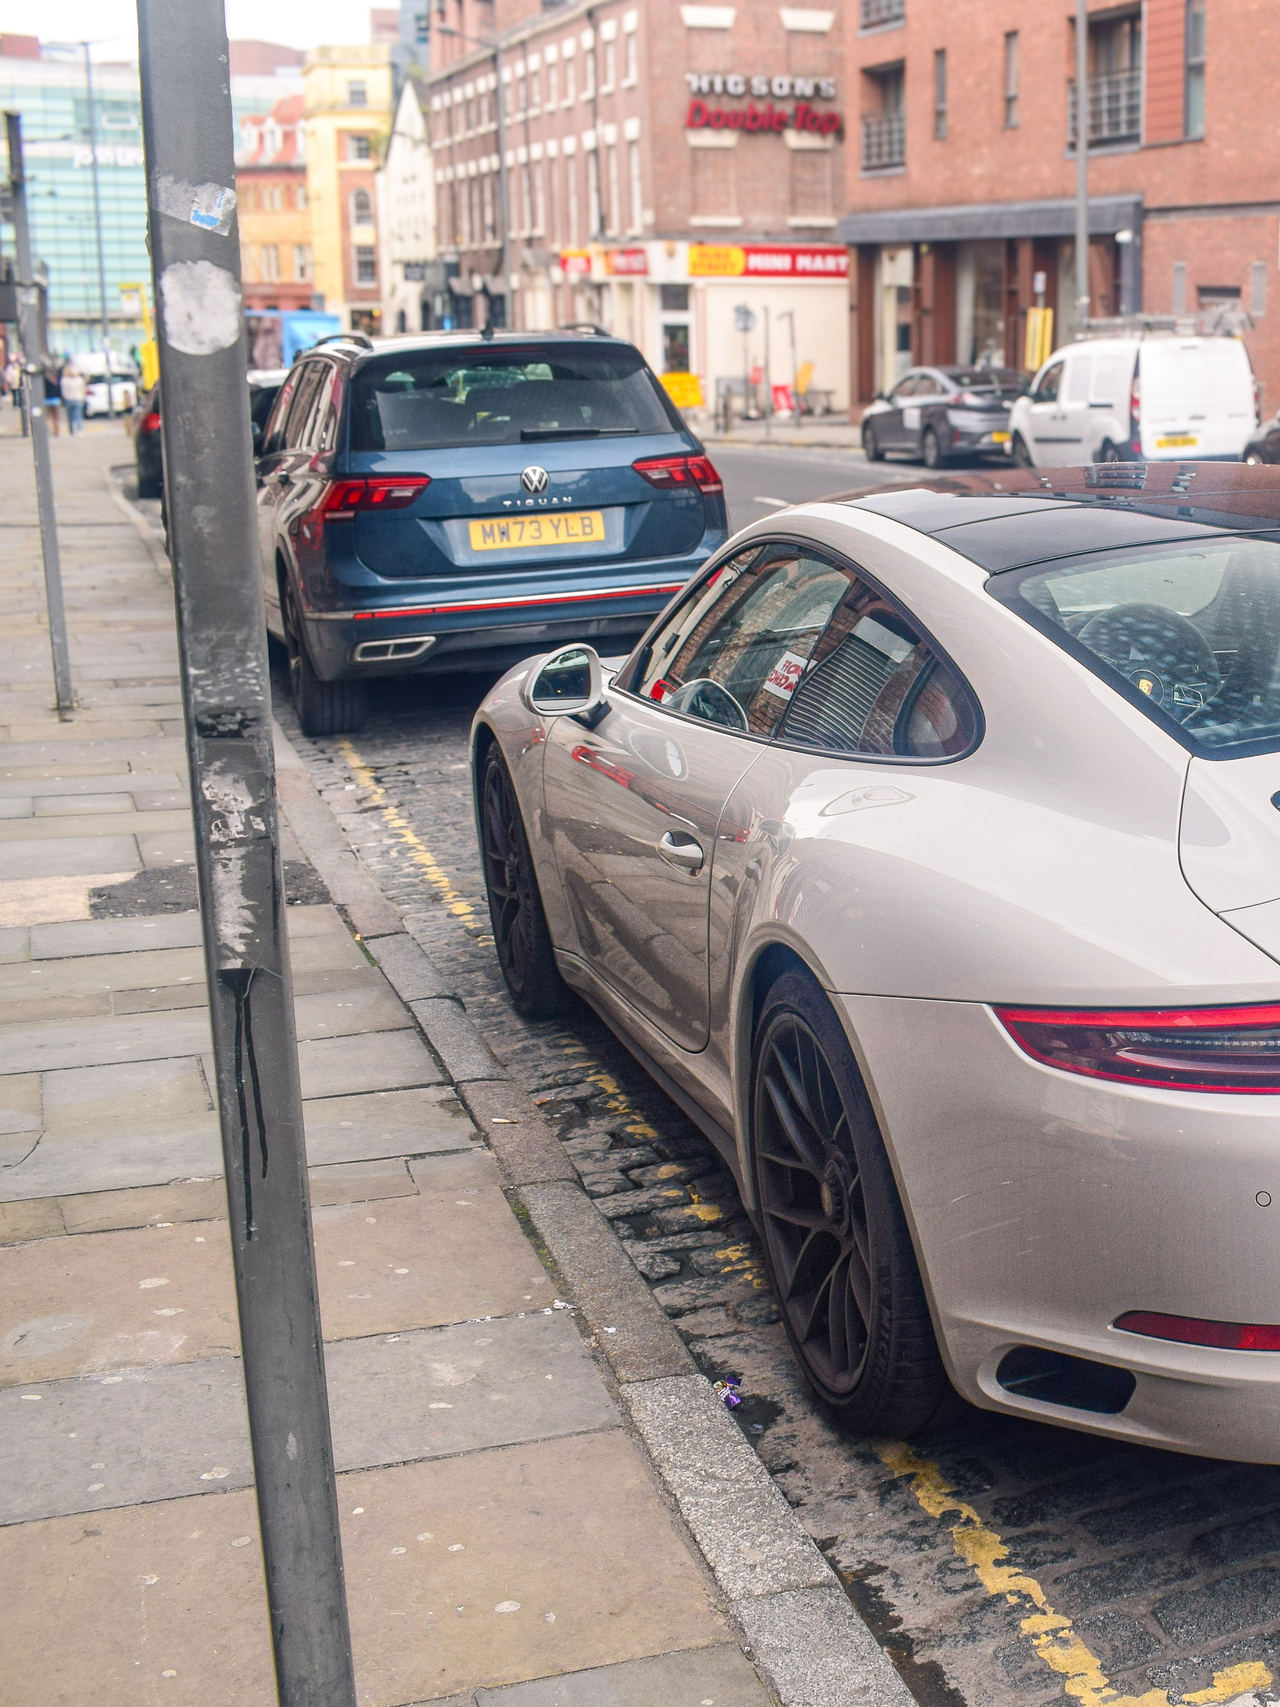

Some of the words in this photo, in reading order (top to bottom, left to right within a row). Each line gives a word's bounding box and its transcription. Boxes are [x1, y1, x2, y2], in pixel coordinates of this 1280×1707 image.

[689, 73, 836, 97] HIGSONS
[685, 100, 788, 131] Double
[795, 104, 841, 137] Top
[747, 254, 792, 271] MINI
[796, 255, 849, 272] MART
[502, 496, 573, 508] TIGUAN
[480, 519, 543, 545] MW73
[549, 515, 594, 539] YLB
